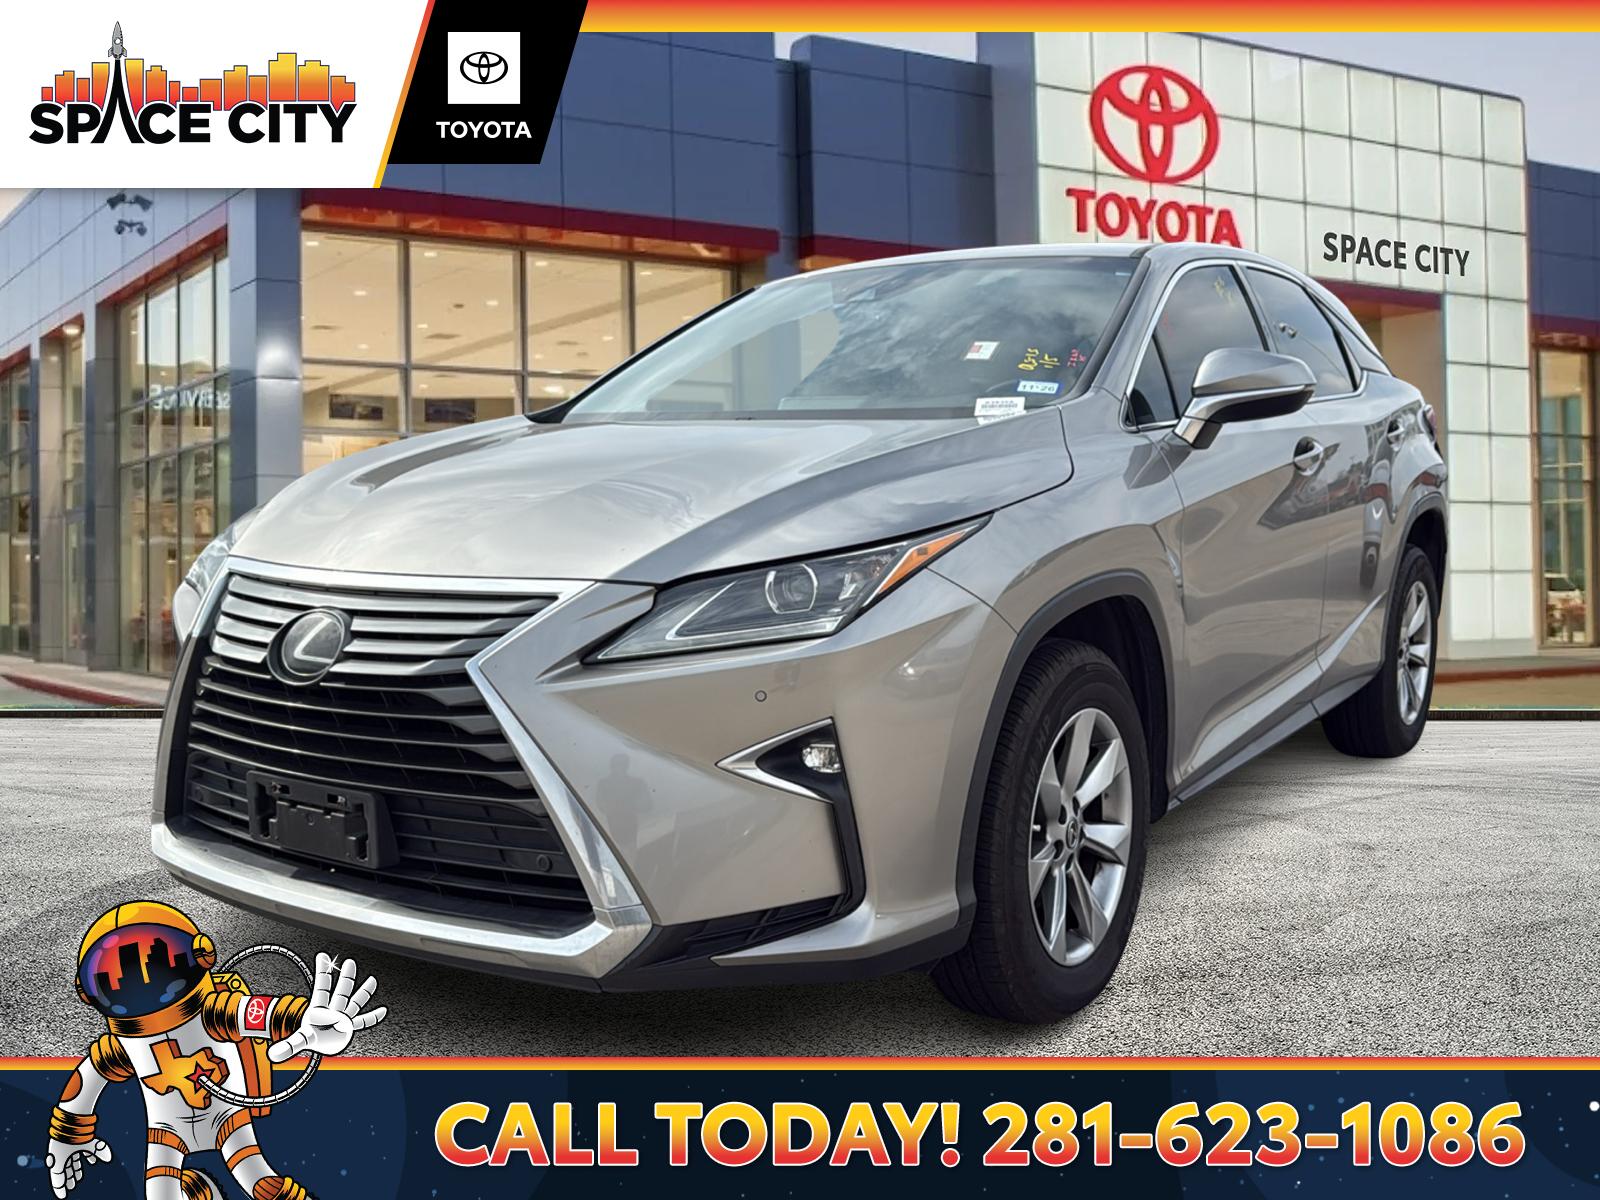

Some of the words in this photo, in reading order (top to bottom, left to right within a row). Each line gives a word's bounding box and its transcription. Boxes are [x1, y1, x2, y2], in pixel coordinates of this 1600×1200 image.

[1065, 188, 1244, 247] TOYOTA
[1322, 231, 1407, 270] SPACE
[1414, 243, 1470, 277] CITY
